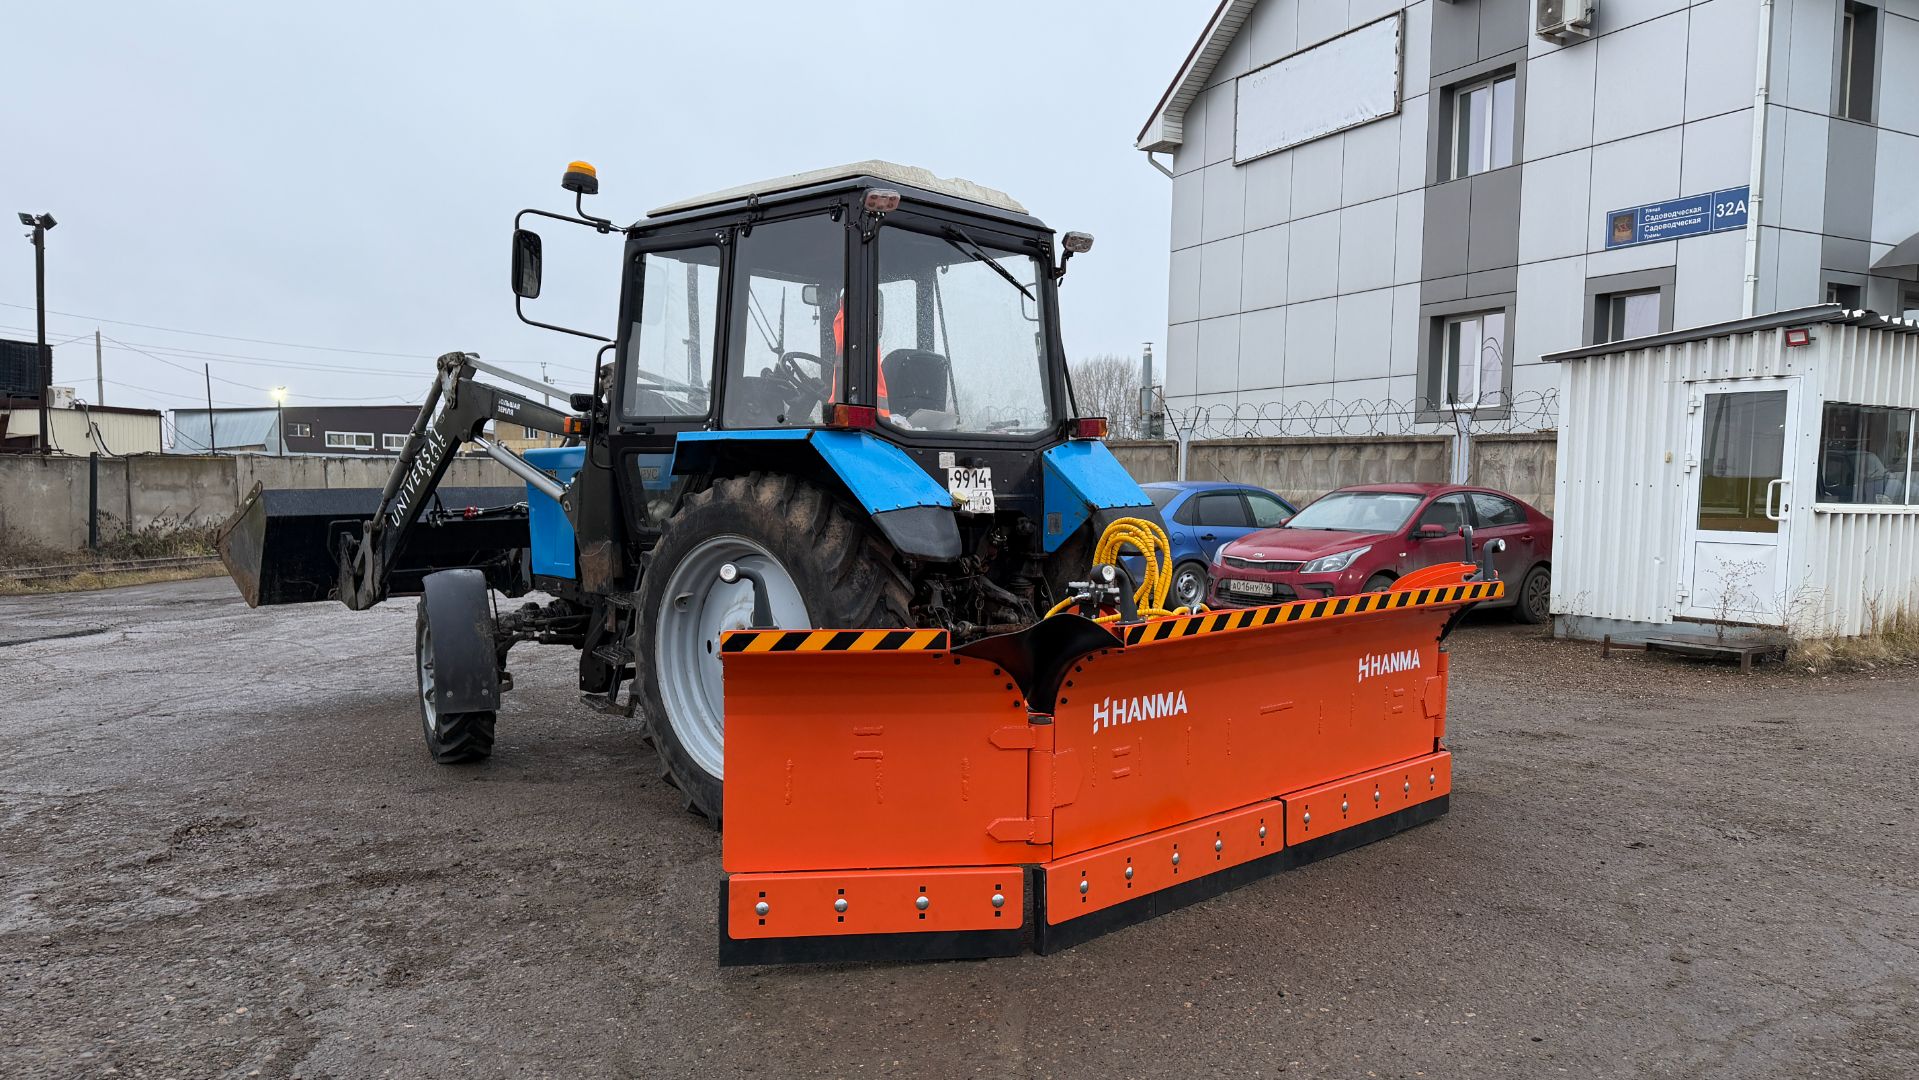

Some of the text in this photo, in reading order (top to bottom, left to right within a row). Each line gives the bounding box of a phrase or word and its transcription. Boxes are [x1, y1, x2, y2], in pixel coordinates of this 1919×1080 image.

[1645, 207, 1702, 222] Садоводческая
[1716, 200, 1746, 218] 32А
[1644, 218, 1701, 232] Садоводческая
[426, 438, 447, 477] BASIC
[391, 428, 442, 527] UNIVERSAL
[954, 469, 987, 489] 9914
[1370, 649, 1420, 677] HANMA
[1112, 690, 1188, 726] HANMA
